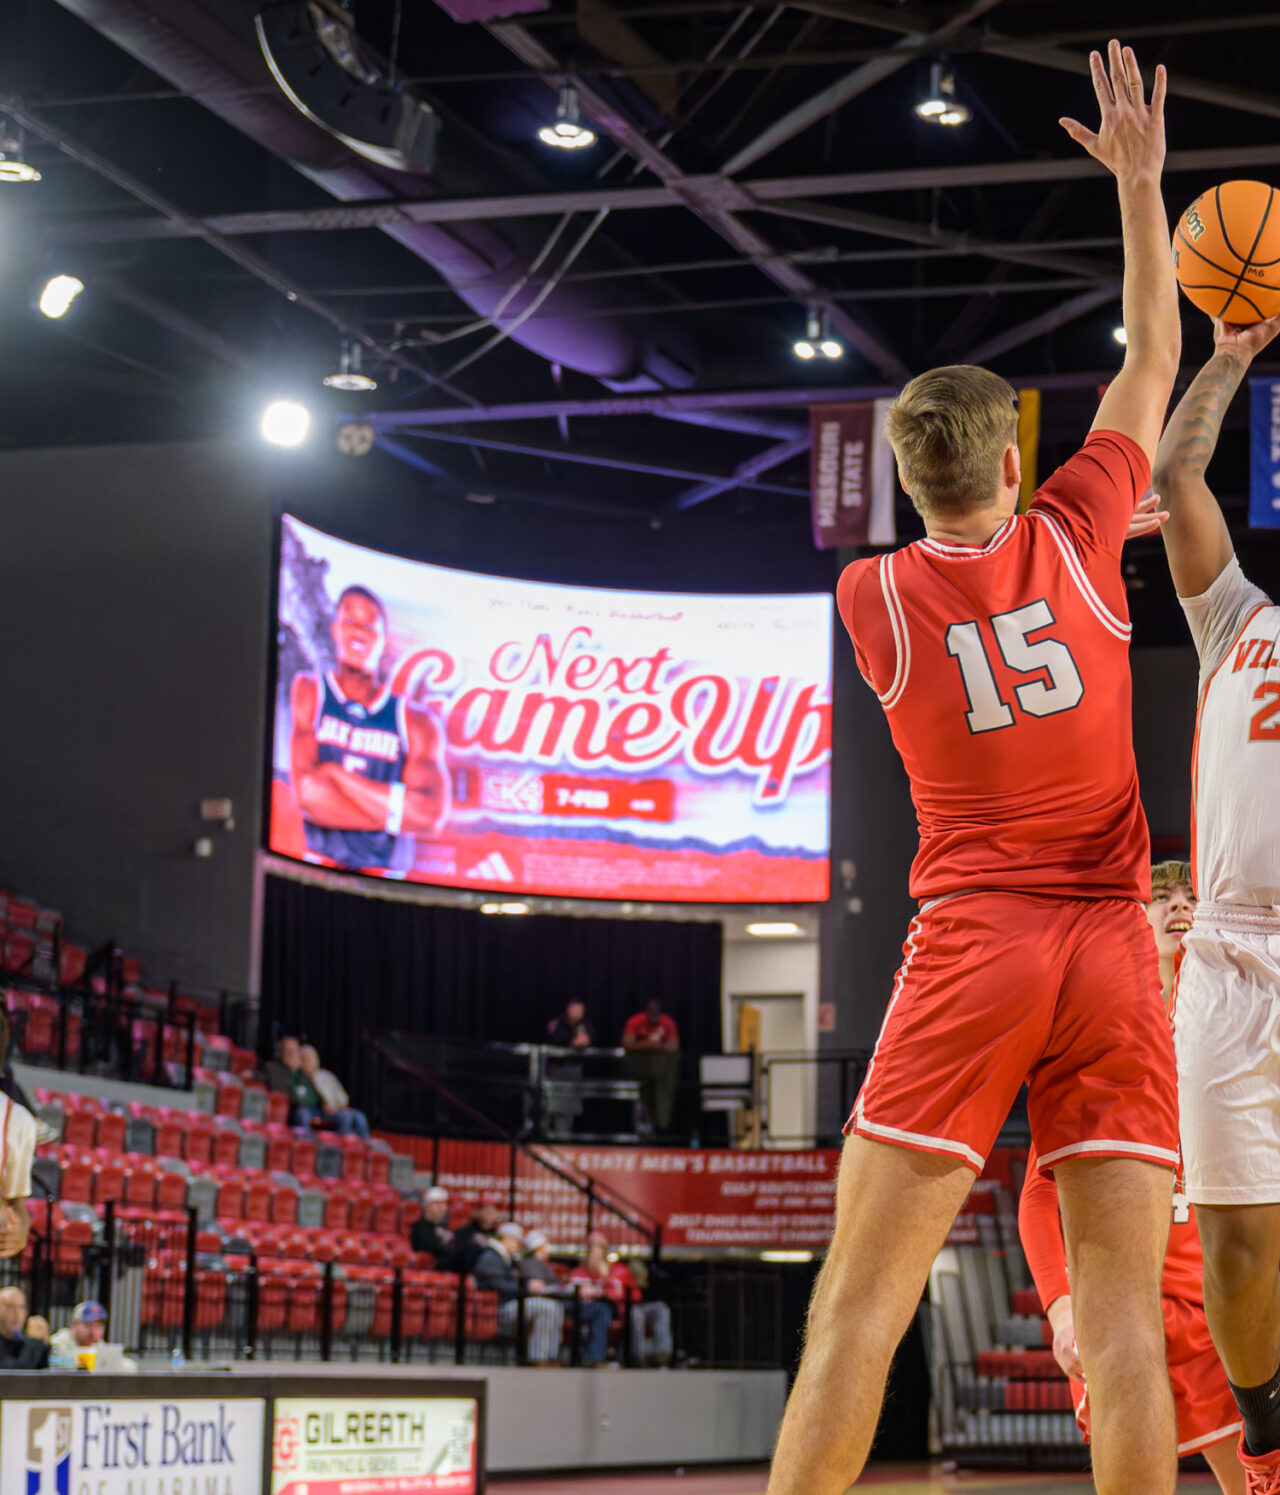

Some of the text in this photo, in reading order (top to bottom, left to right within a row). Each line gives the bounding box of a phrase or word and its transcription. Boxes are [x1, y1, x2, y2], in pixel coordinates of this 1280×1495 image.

[817, 420, 842, 529] MISSOURI
[842, 440, 864, 507] STATE
[489, 624, 674, 695] Next
[946, 598, 1085, 734] 15
[391, 648, 683, 764] Game
[578, 1154, 639, 1172] STATE
[641, 1154, 705, 1172] MEN'S
[708, 1154, 828, 1173] BASKETBALL
[80, 1403, 236, 1469] First Bank
[305, 1411, 426, 1445] GILREATH
